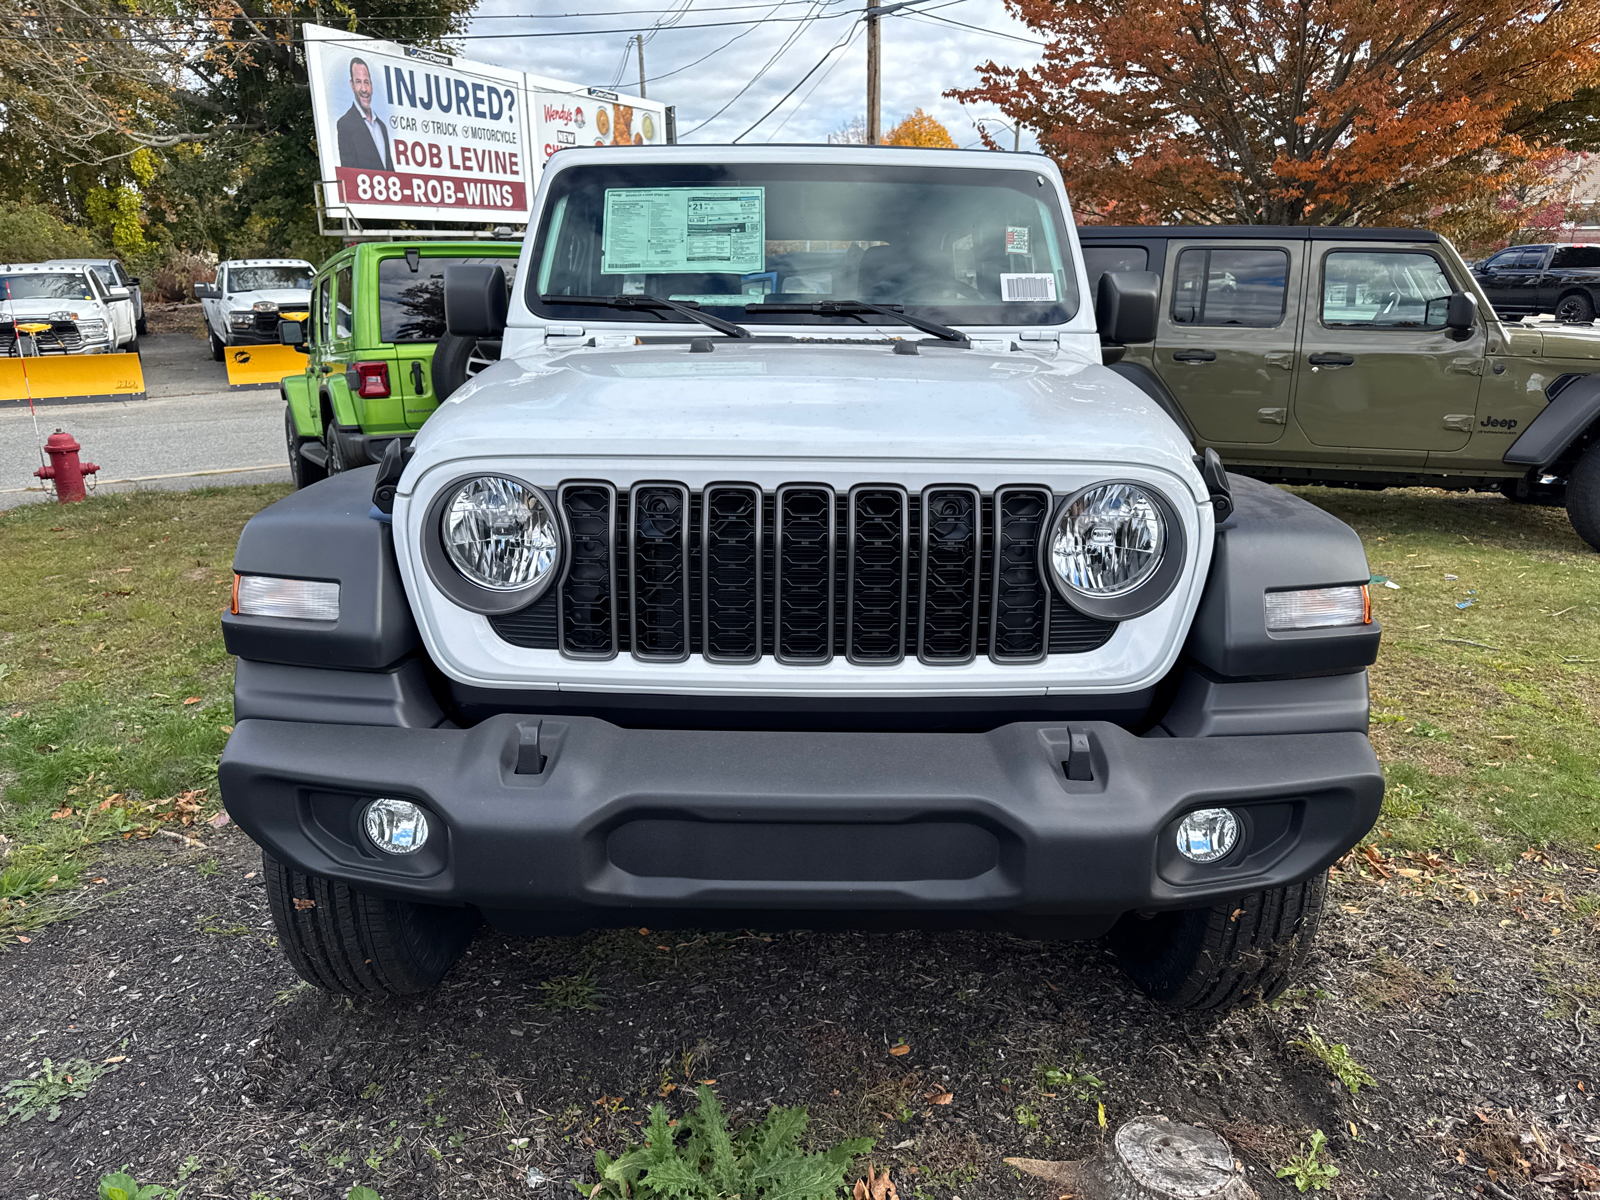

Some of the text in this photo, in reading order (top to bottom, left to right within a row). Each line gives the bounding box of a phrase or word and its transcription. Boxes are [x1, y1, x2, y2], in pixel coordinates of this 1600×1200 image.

[384, 65, 515, 123] INJURED?
[544, 104, 573, 126] Wendy's
[400, 116, 517, 144] CAR TRUCK MOTORCYCLE
[558, 131, 575, 144] NEW
[394, 139, 520, 176] ROB LEVINE
[356, 173, 514, 207] 888-ROB-WINS
[692, 203, 703, 211] 21
[1480, 415, 1518, 430] Jeep
